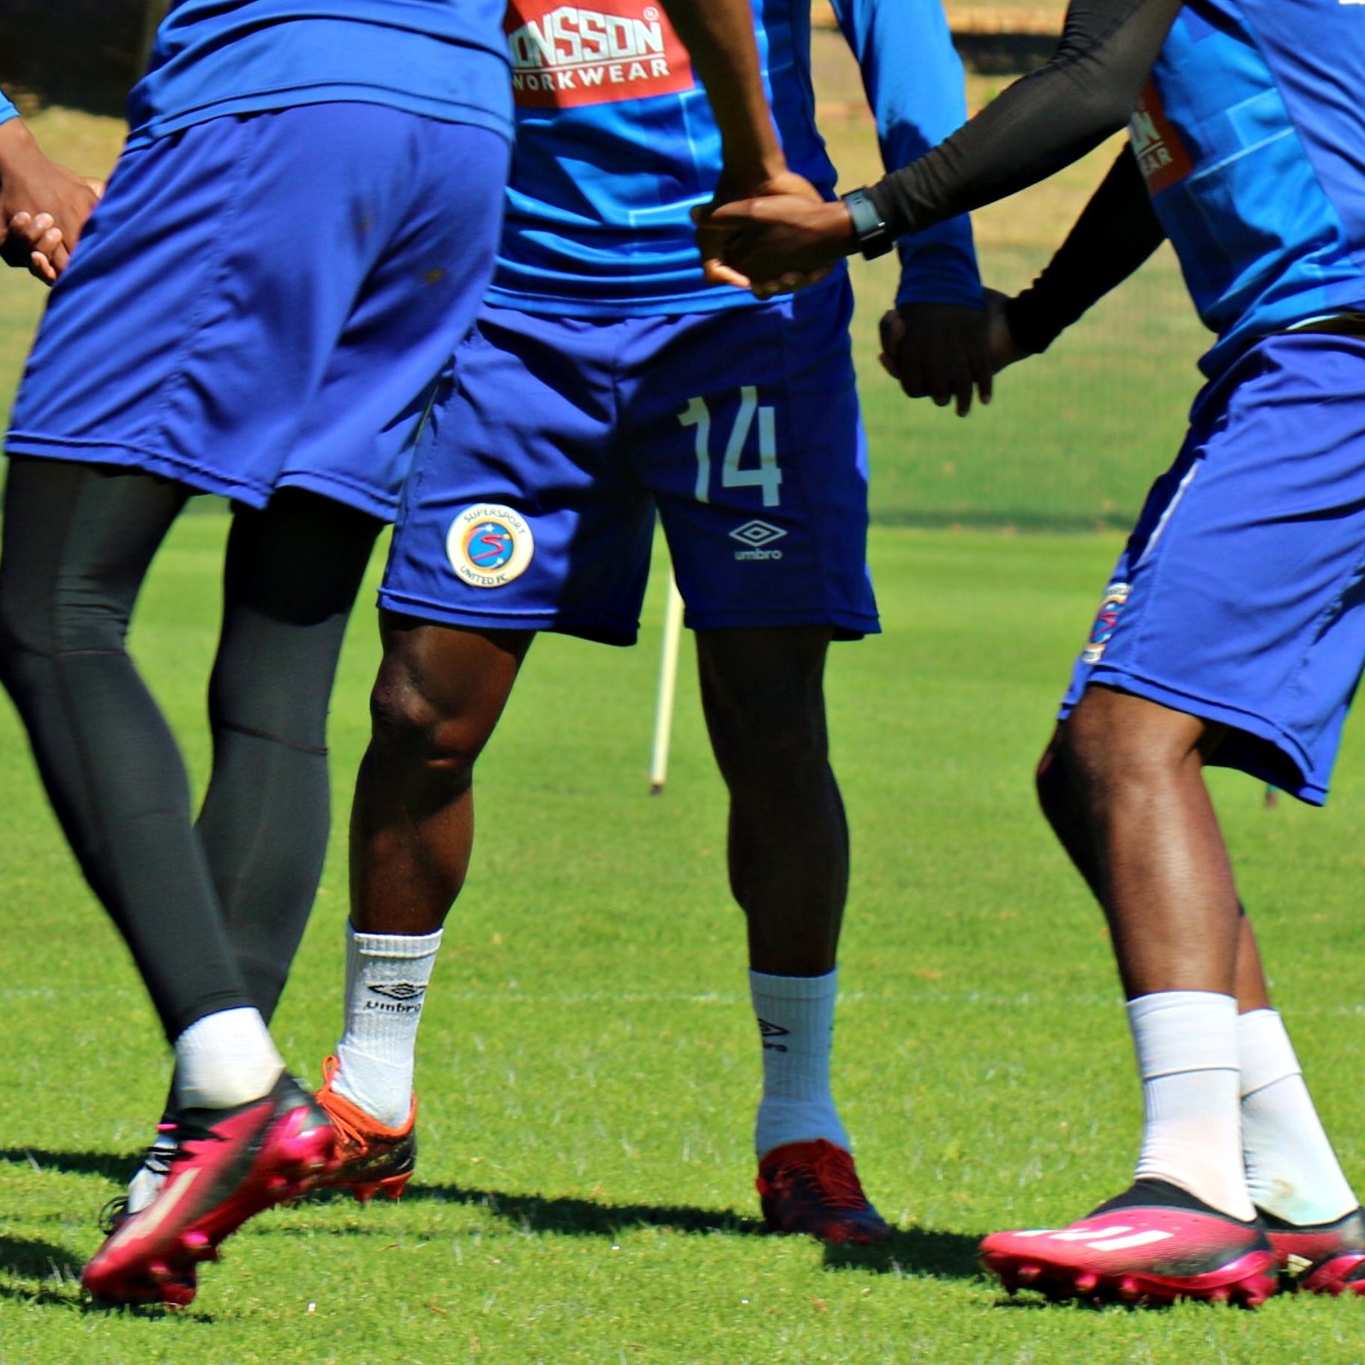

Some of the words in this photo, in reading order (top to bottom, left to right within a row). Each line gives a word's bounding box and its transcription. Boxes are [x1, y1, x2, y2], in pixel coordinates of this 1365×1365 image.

[507, 5, 666, 68] ONSSON
[677, 385, 783, 507] 14
[733, 547, 783, 561] umbro
